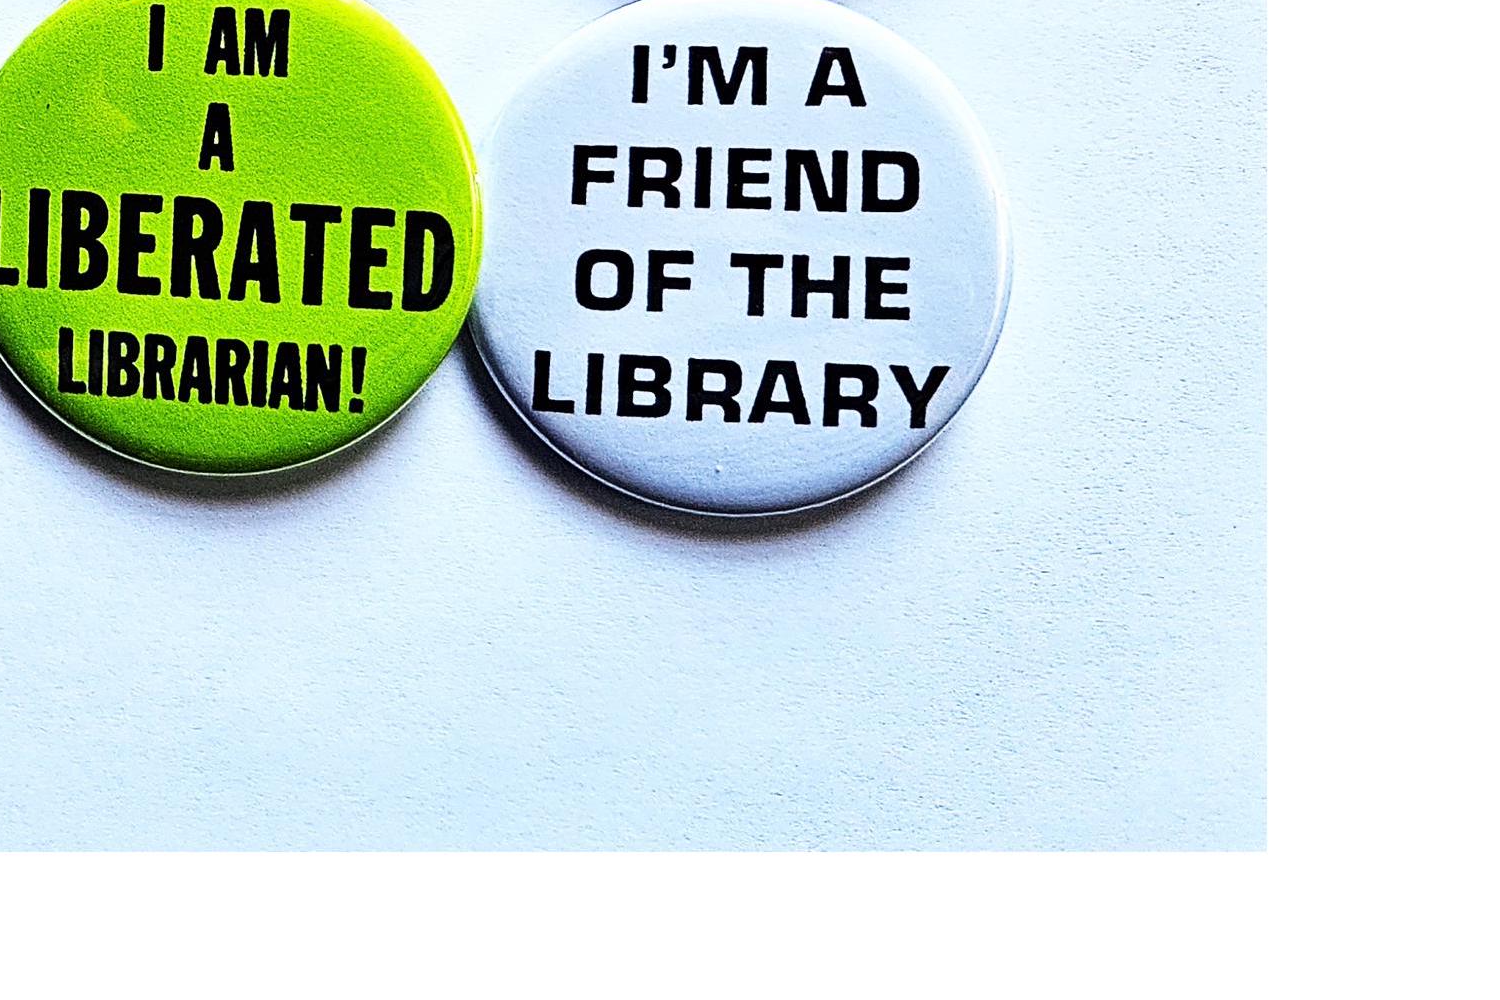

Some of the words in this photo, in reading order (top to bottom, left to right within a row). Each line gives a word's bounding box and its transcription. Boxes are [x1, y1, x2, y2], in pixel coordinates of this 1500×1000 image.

[148, 4, 165, 72] I
[204, 6, 290, 77] AM
[632, 44, 768, 106] I'M
[805, 47, 866, 107] A
[198, 102, 235, 172] A
[571, 145, 919, 213] FRIEND
[575, 249, 694, 312] OF
[730, 253, 910, 321] THE
[57, 327, 367, 413] LIBRARIAN!
[532, 350, 951, 429] LIBRARY
